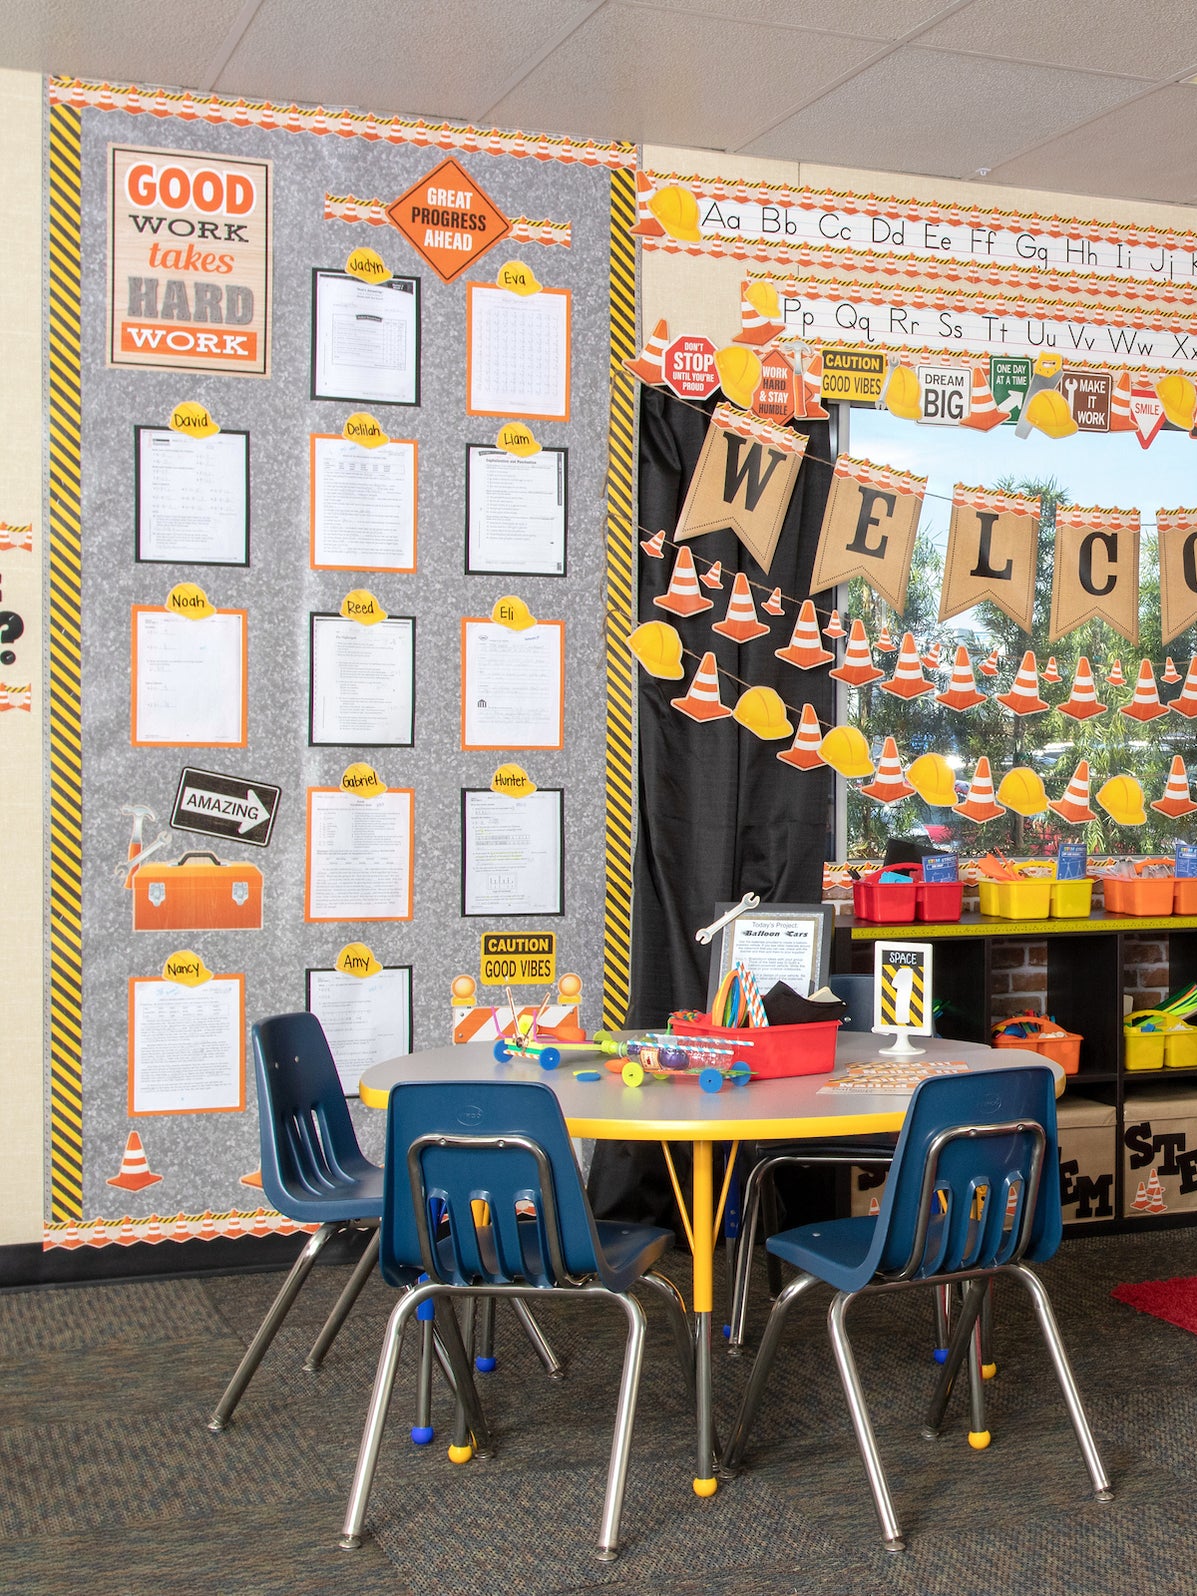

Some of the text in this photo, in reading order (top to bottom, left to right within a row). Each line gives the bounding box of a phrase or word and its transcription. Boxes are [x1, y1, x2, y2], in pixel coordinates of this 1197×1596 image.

[126, 163, 255, 215] GOOD
[427, 187, 473, 209] GREAT
[411, 207, 487, 232] PROGRESS
[128, 215, 249, 242] WORK
[423, 229, 473, 252] AHEAD
[149, 241, 235, 275] takes
[350, 257, 385, 277] Jadyn
[503, 271, 527, 287] Eva
[127, 277, 254, 326] HARD
[127, 328, 249, 356] WORK
[684, 342, 704, 351] DON'T
[673, 352, 714, 372] STOP
[826, 354, 880, 370] CAUTION
[997, 364, 1026, 374] ONE DAY
[672, 372, 714, 382] UNTIL YOU'RE
[762, 366, 788, 379] WORK
[925, 374, 964, 387] DREAM
[682, 382, 704, 391] PROUD
[763, 379, 786, 390] HARD
[823, 375, 881, 395] GOOD VIBES
[1012, 376, 1027, 386] TIME
[1080, 380, 1105, 394] MAKE
[759, 392, 788, 404] & STAY
[924, 389, 964, 419] BIG
[1088, 396, 1096, 408] IT
[758, 404, 787, 416] HUMBLE
[1135, 402, 1160, 416] SMILE
[174, 412, 209, 430] David
[1077, 411, 1105, 426] WORK
[347, 423, 381, 438] Delilah
[504, 432, 530, 448] Liam
[172, 594, 206, 610] Noah
[347, 600, 374, 616] Reed
[500, 605, 514, 620] Eli
[343, 771, 379, 790] Gabriel
[495, 773, 528, 788] Hunter
[186, 793, 260, 821] AMAZING
[488, 938, 549, 954] CAUTION
[344, 953, 370, 972] Amy
[889, 952, 917, 965] SPACE
[167, 961, 201, 979] Nancy
[485, 958, 551, 980] GOOD VIBES
[891, 968, 913, 1023] 1
